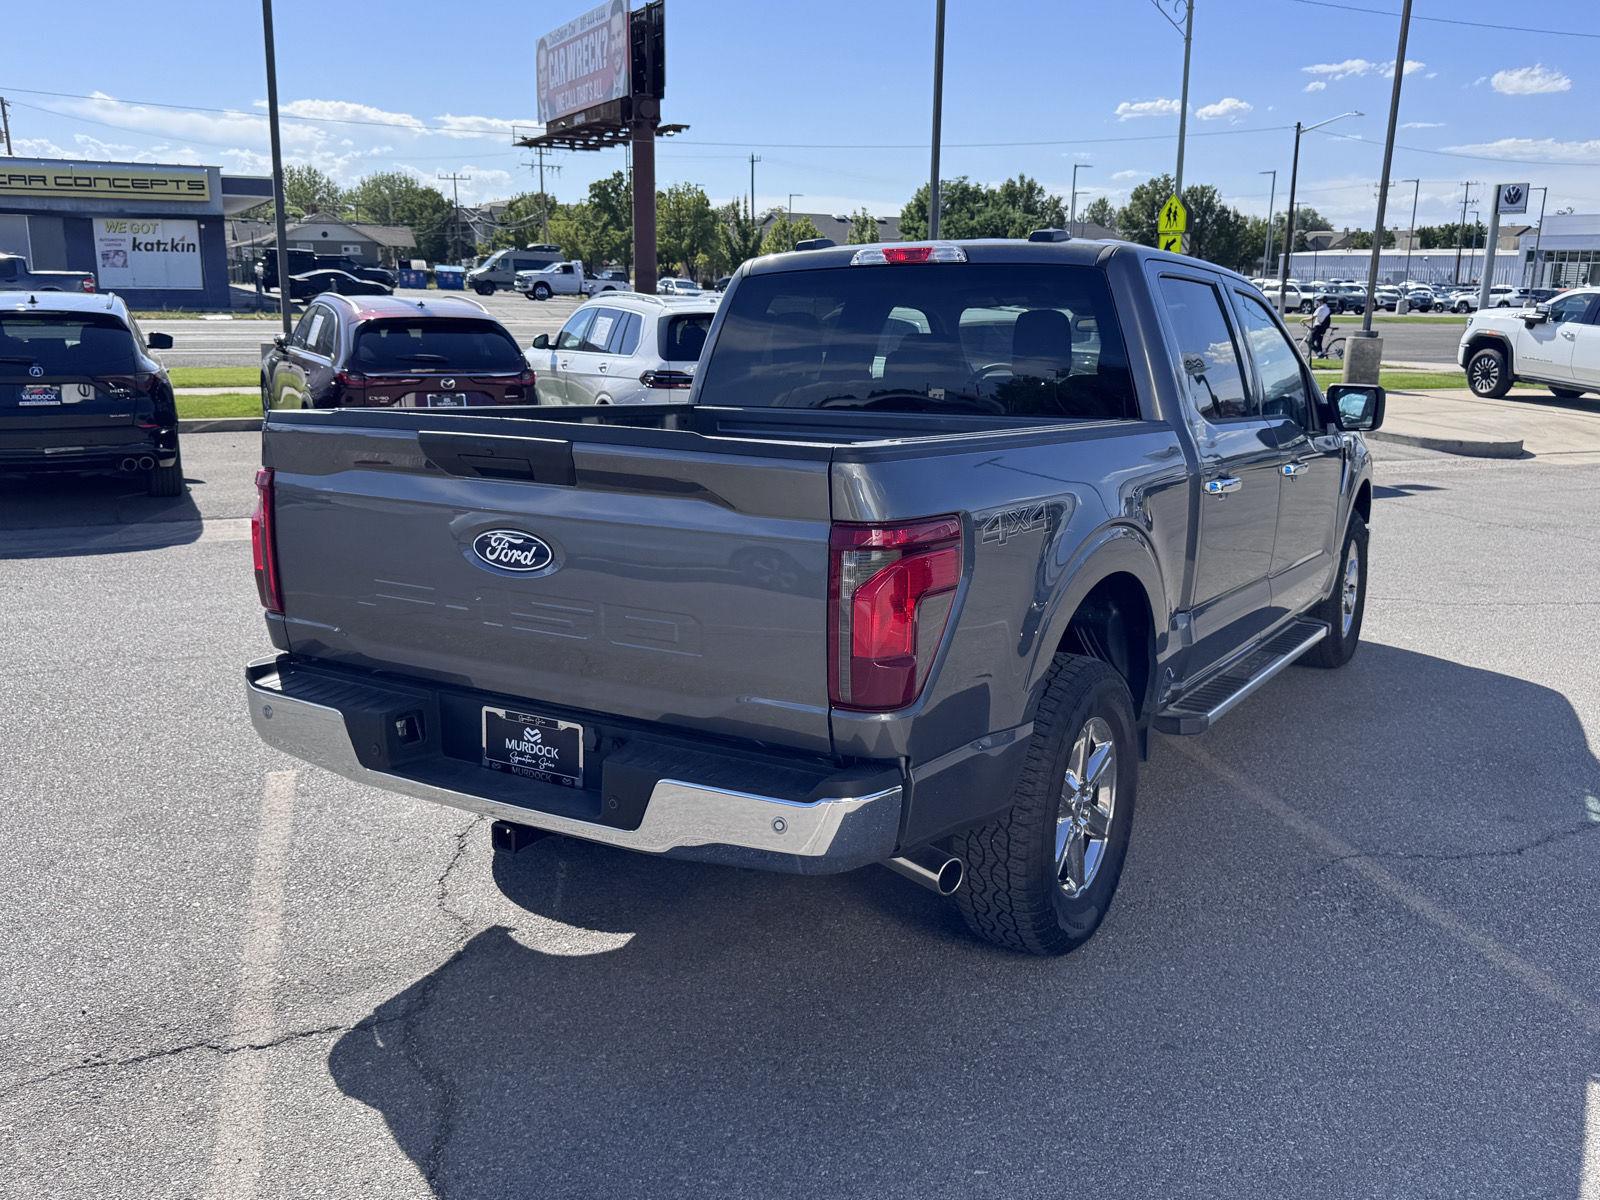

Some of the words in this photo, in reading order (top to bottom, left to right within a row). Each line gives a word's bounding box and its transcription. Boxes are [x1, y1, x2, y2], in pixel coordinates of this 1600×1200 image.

[549, 47, 566, 90] CAR
[567, 27, 608, 82] WRECK?
[54, 175, 205, 191] CONCEPTS
[105, 220, 127, 234] WE
[130, 222, 159, 234] GOT
[132, 236, 196, 253] katzkin
[486, 533, 536, 566] Ford
[505, 738, 560, 760] MURDOCK
[512, 766, 553, 783] MURDOCK
